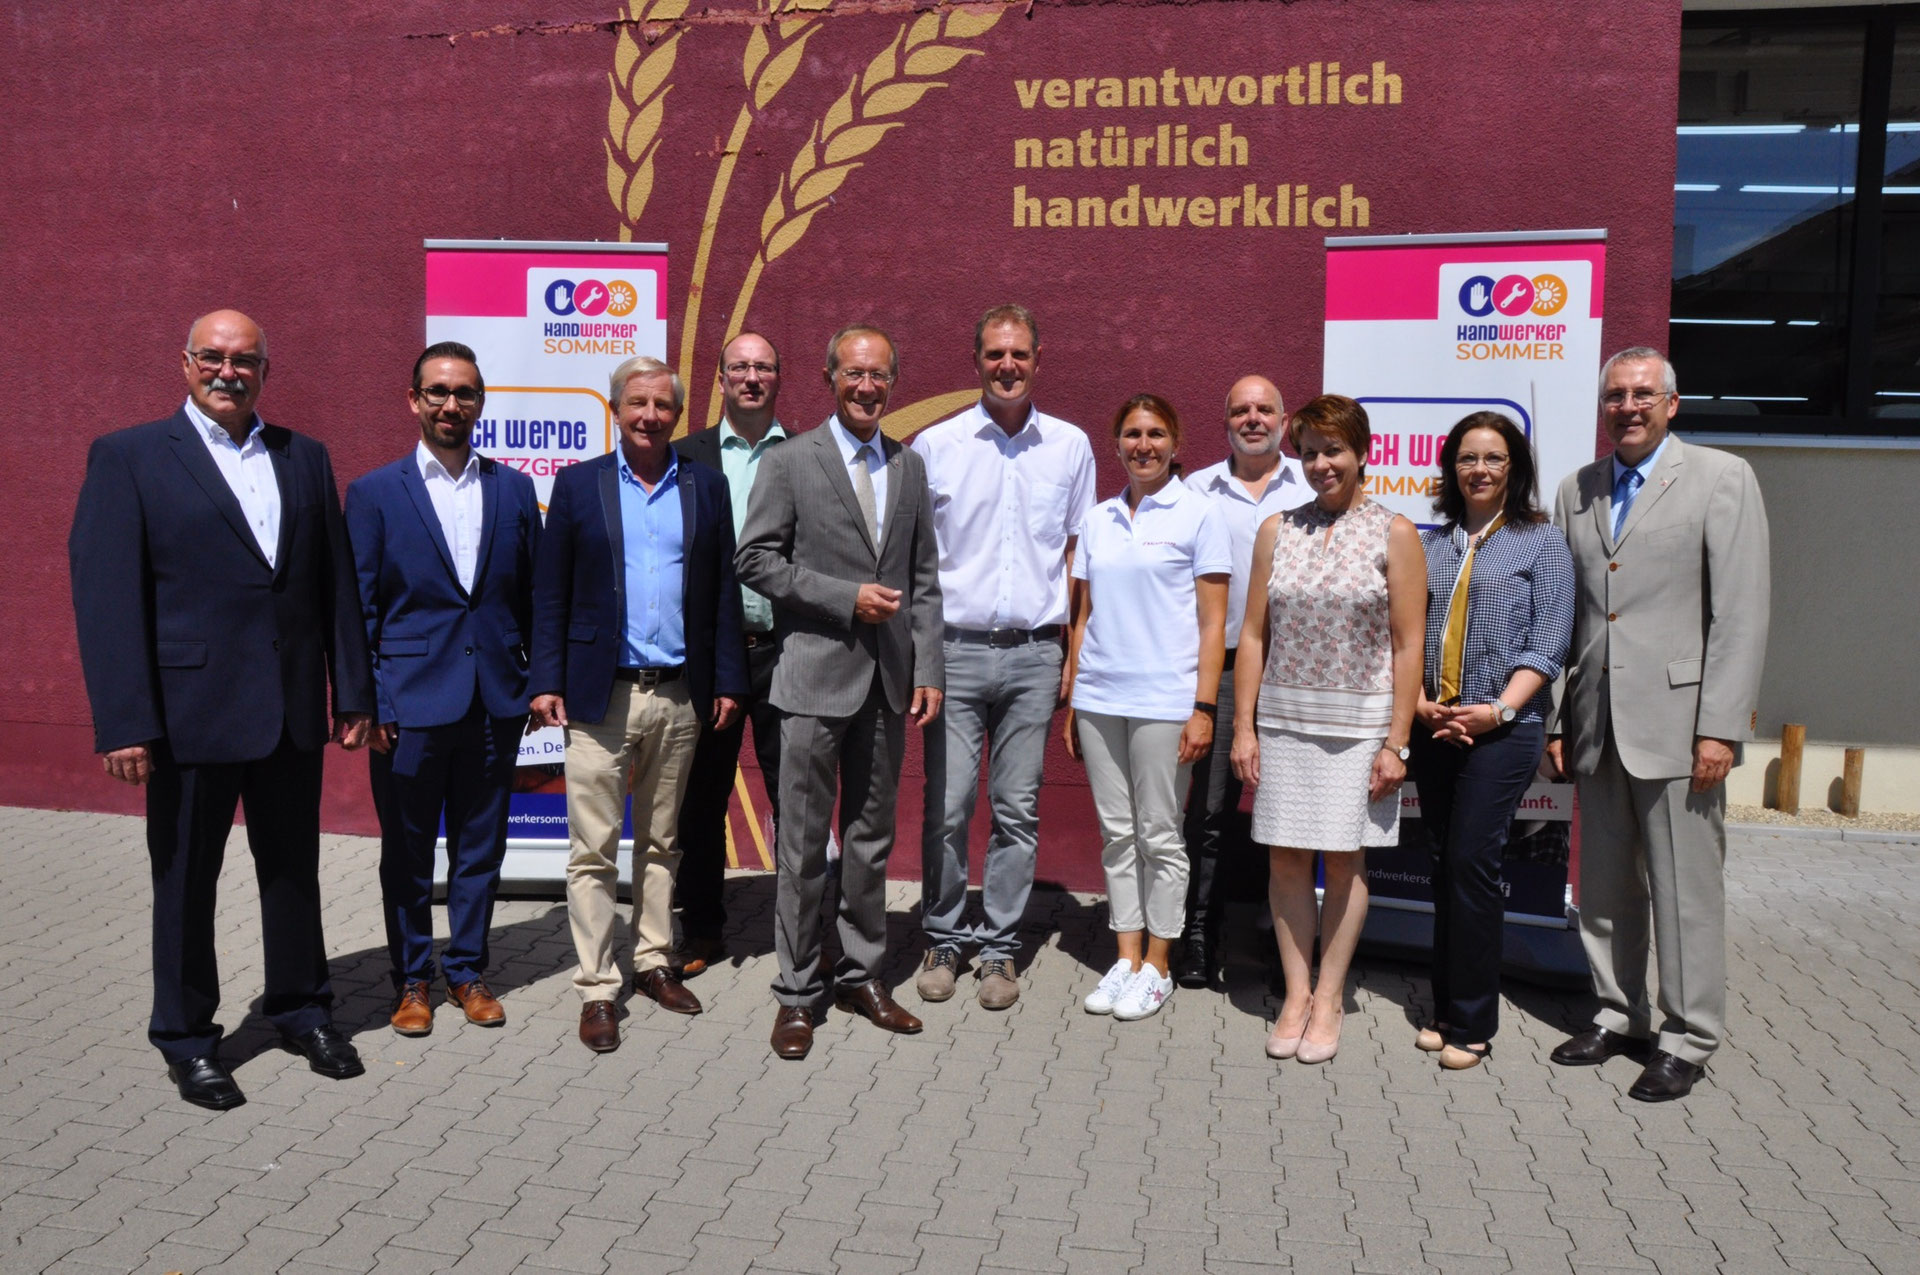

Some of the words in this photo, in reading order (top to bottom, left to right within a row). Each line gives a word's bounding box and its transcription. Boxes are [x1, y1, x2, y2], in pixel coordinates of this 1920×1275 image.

[1014, 60, 1402, 108] verantwortlich
[1014, 123, 1249, 168] natürlich
[1013, 183, 1370, 227] handwerklich
[544, 338, 636, 355] SOMMER
[1455, 343, 1564, 360] SOMMER
